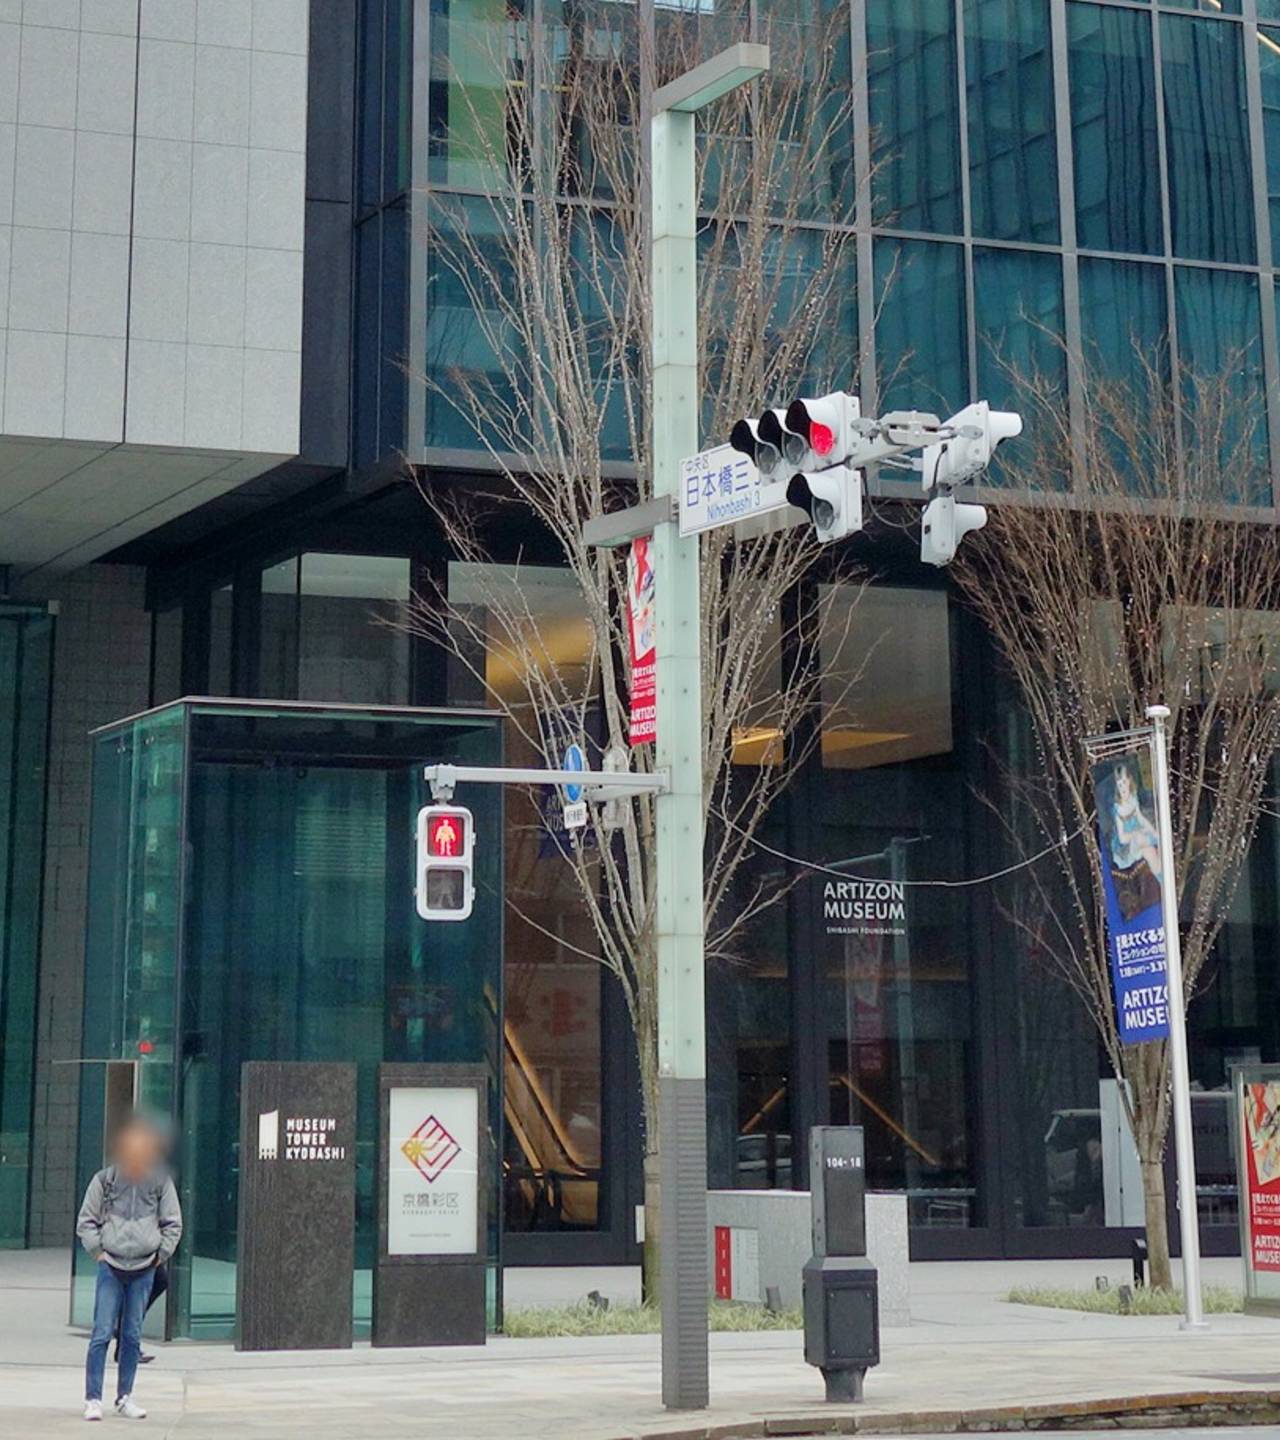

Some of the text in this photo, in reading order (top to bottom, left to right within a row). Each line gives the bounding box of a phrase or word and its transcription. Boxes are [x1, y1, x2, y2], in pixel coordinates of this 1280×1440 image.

[687, 460, 761, 508] 日本橋三
[823, 881, 904, 900] ARTIZON
[823, 901, 905, 920] MUSEUM
[286, 1118, 336, 1131] MUSEUM
[286, 1133, 326, 1146] TOWER
[285, 1147, 345, 1160] KYOBASHI
[402, 1191, 460, 1208] 京橋彩区
